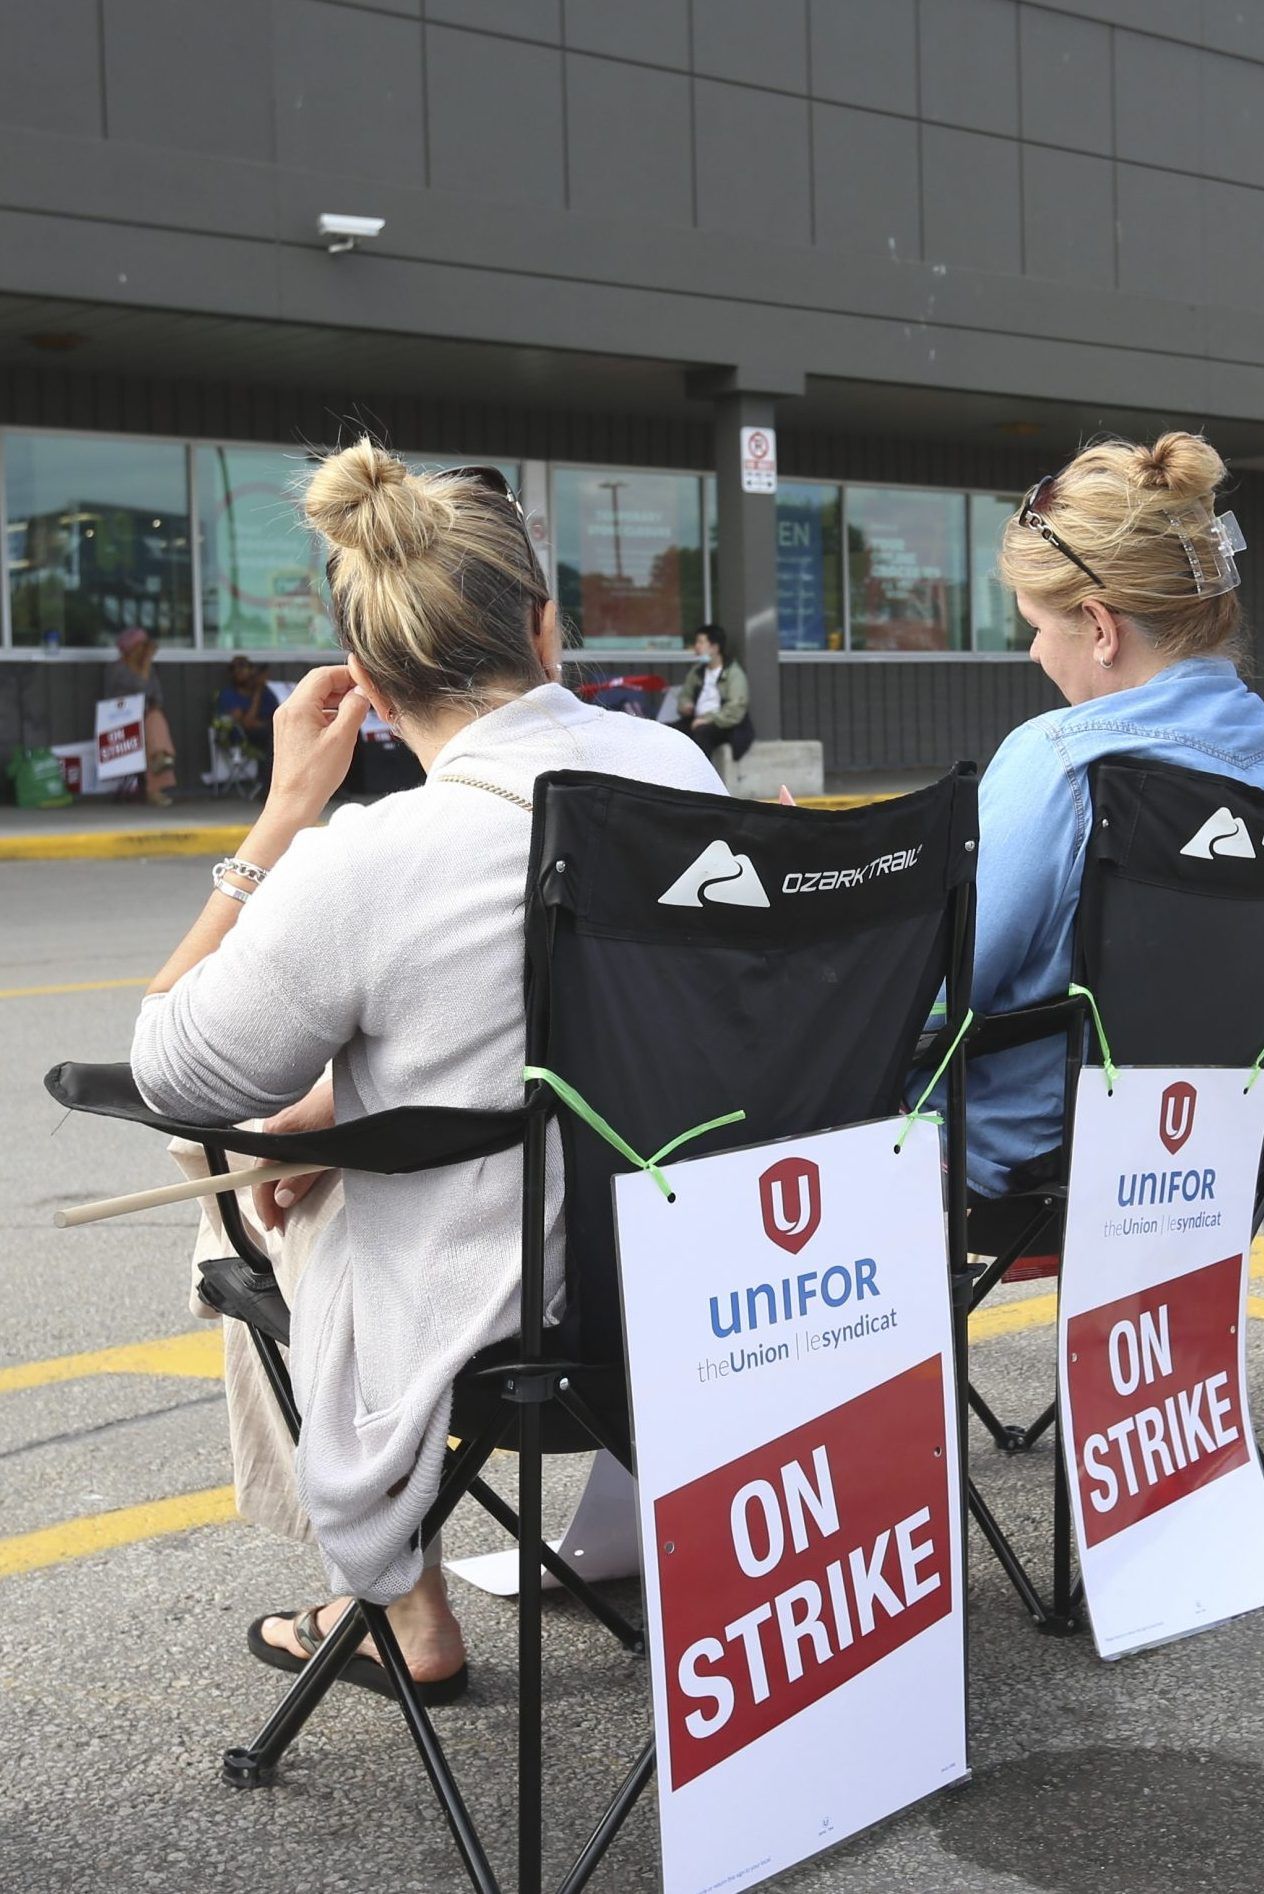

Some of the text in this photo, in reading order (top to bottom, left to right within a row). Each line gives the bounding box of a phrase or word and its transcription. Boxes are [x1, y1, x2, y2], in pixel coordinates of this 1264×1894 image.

[779, 521, 810, 547] EN
[101, 737, 139, 758] STRIKE
[781, 848, 919, 894] OZARK TRAIL
[1104, 1210, 1222, 1239] theUnion lesyndicat
[697, 1308, 898, 1383] theUnion lesyndicat
[1108, 1303, 1174, 1397] ON
[1083, 1370, 1240, 1514] STRIKE
[730, 1444, 841, 1578] ON
[677, 1505, 942, 1740] STRIKE
